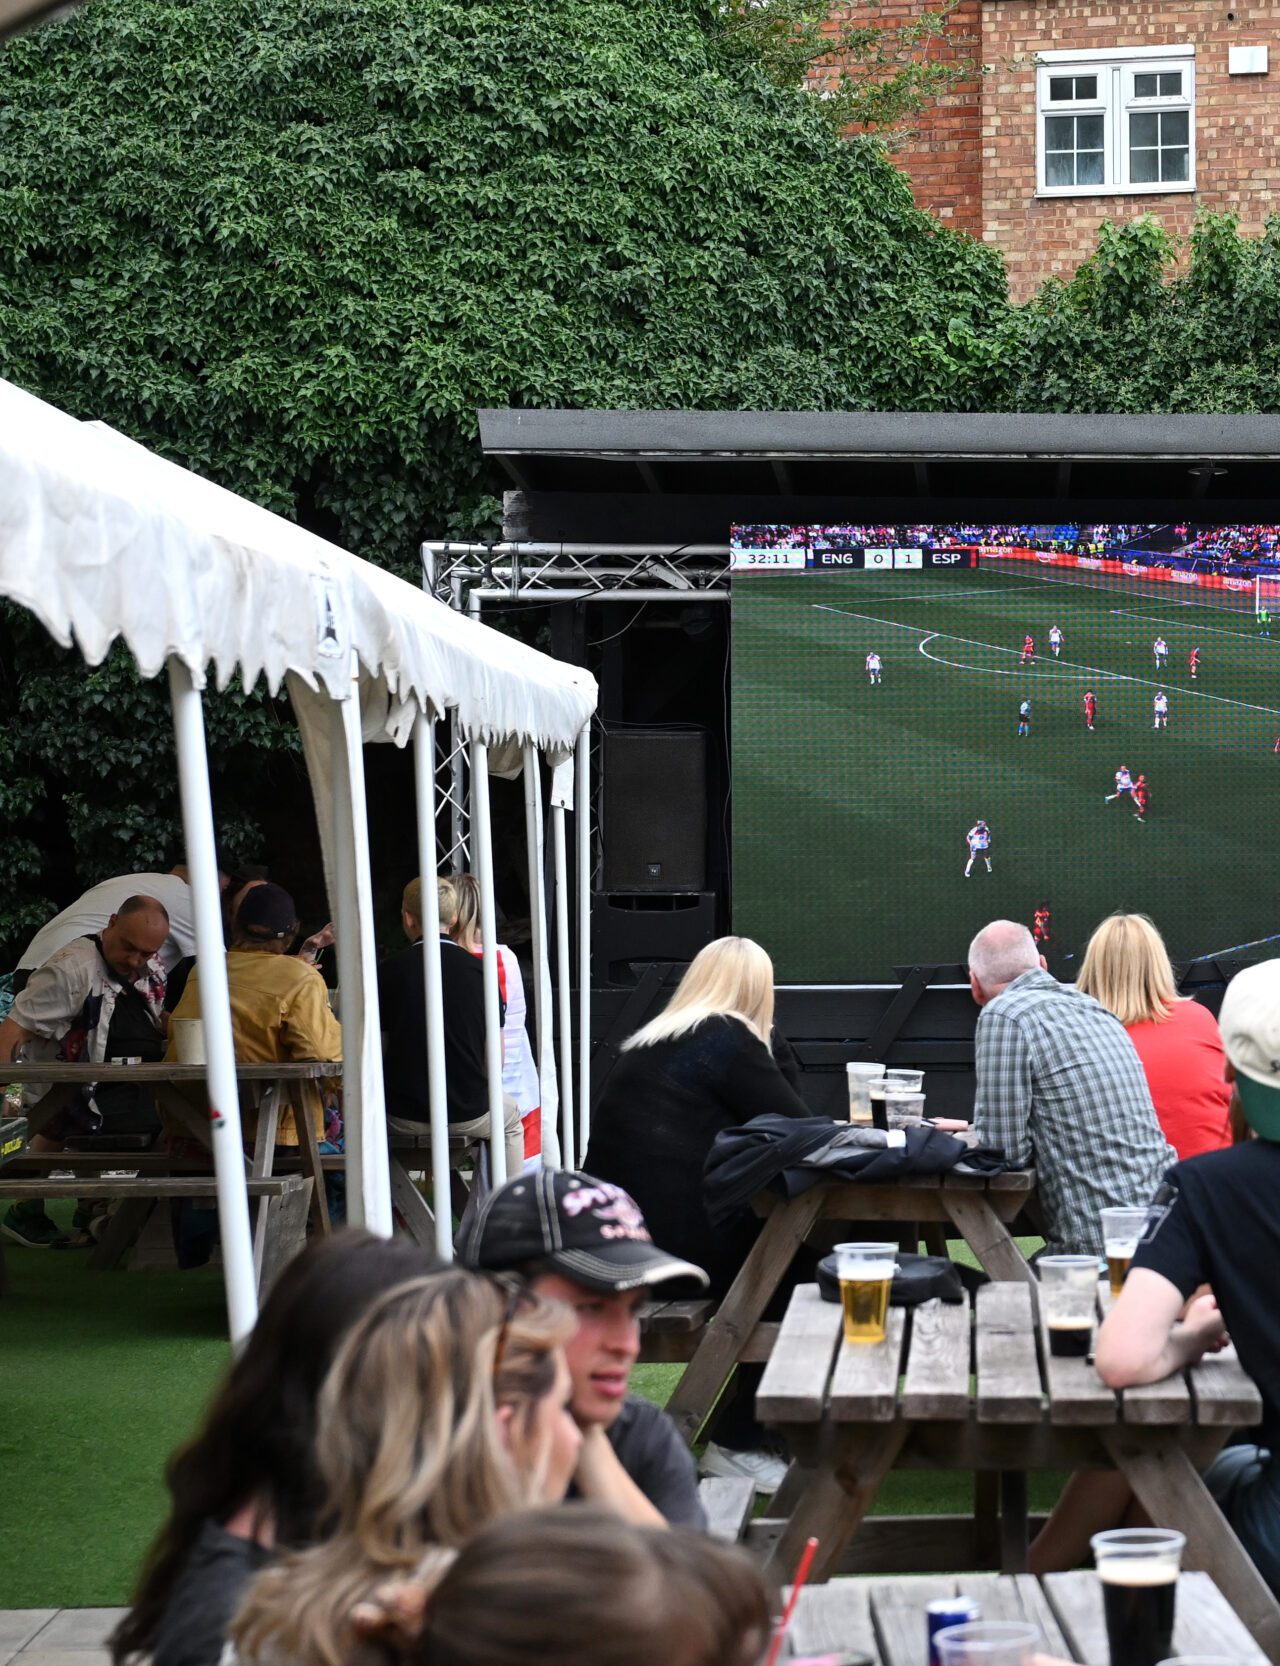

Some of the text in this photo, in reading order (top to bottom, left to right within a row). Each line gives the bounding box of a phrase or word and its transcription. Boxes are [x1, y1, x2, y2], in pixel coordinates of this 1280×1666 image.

[978, 546, 1013, 554] amazon
[748, 553, 962, 564] 32:11 ENG 0 1 ESP
[1170, 570, 1198, 579] amazon
[1223, 578, 1252, 587] amazon
